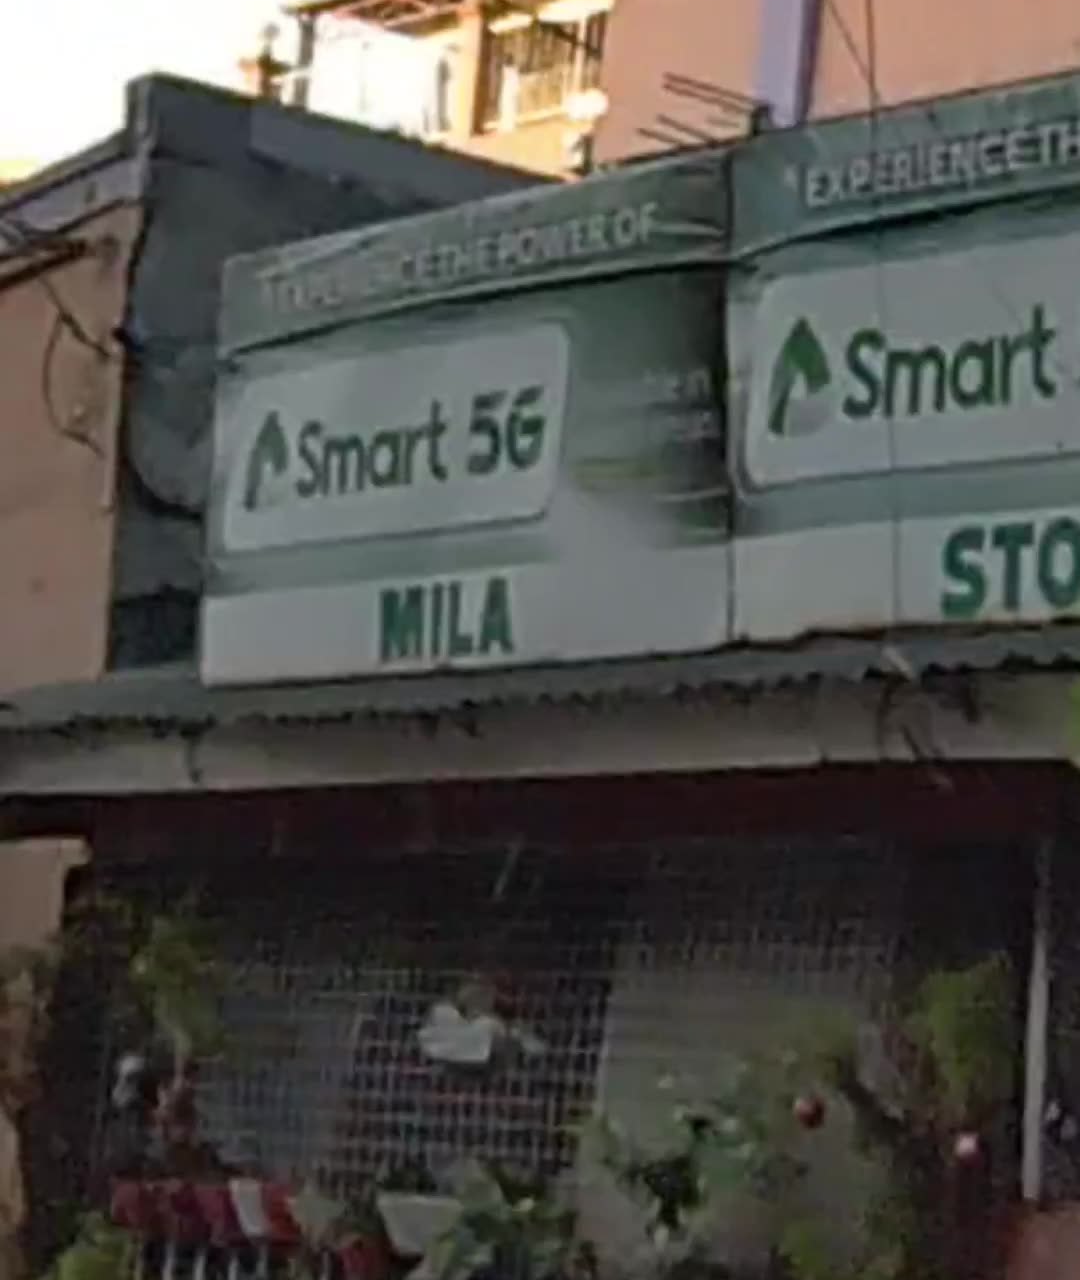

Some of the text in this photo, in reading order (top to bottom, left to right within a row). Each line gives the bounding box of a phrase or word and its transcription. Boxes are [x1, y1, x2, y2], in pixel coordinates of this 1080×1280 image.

[805, 127, 1034, 207] EXPERIENCE
[614, 201, 657, 245] OF
[842, 303, 1056, 420] Smart
[296, 398, 448, 498] Smart
[468, 386, 546, 475] 5G
[379, 577, 514, 663] MILA
